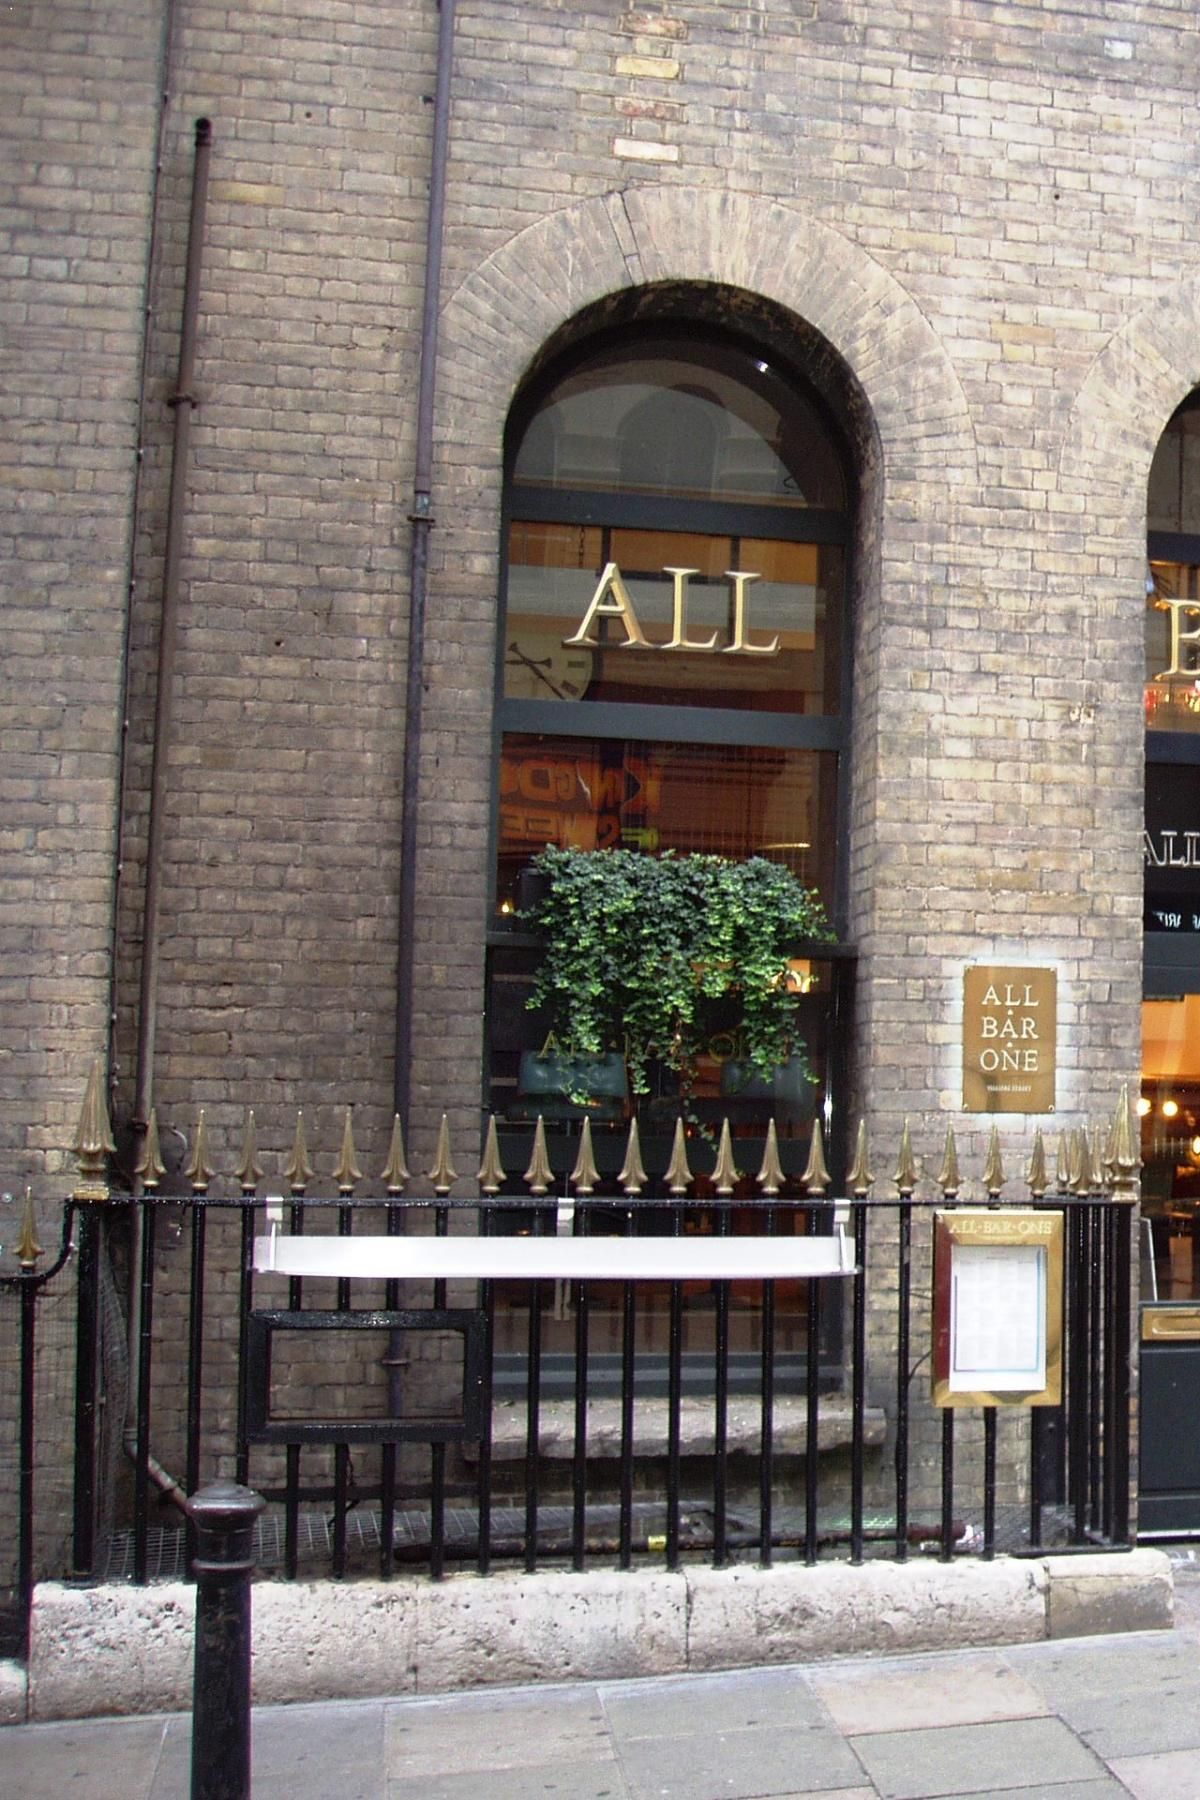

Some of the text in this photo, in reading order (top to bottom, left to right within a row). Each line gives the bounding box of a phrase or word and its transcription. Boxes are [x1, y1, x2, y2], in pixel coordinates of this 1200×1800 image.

[562, 562, 782, 656] ALL
[981, 983, 1039, 1007] ALL
[981, 1016, 1039, 1040] BAR
[980, 1048, 1039, 1072] ONE
